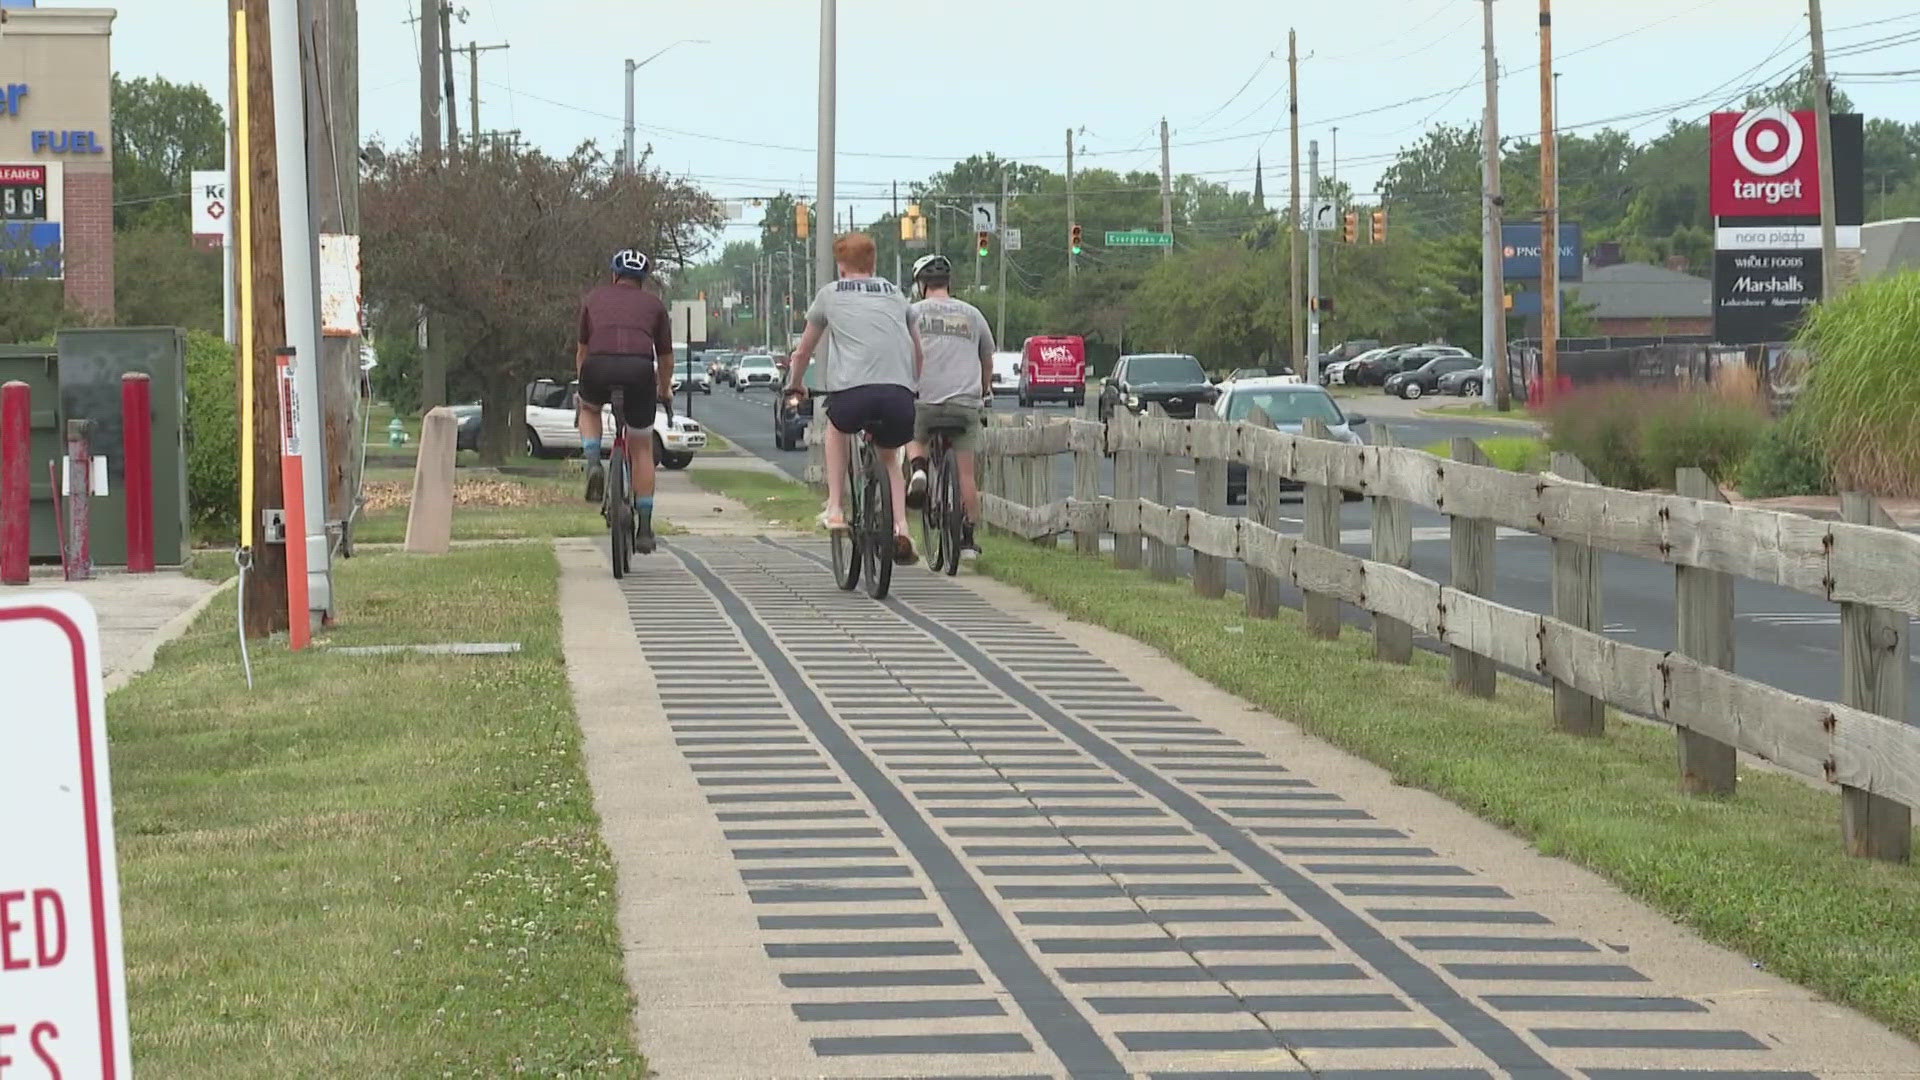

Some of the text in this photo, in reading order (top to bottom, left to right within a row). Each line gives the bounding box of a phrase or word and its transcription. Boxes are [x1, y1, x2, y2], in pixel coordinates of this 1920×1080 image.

[31, 131, 103, 153] FUEL
[1733, 178, 1802, 204] target
[1109, 235, 1155, 244] Evergreen
[1736, 232, 1805, 244] nora plaza
[1517, 247, 1541, 256] PNC
[1734, 255, 1803, 268] WHOLE FOODS
[1732, 276, 1804, 292] Marshalls
